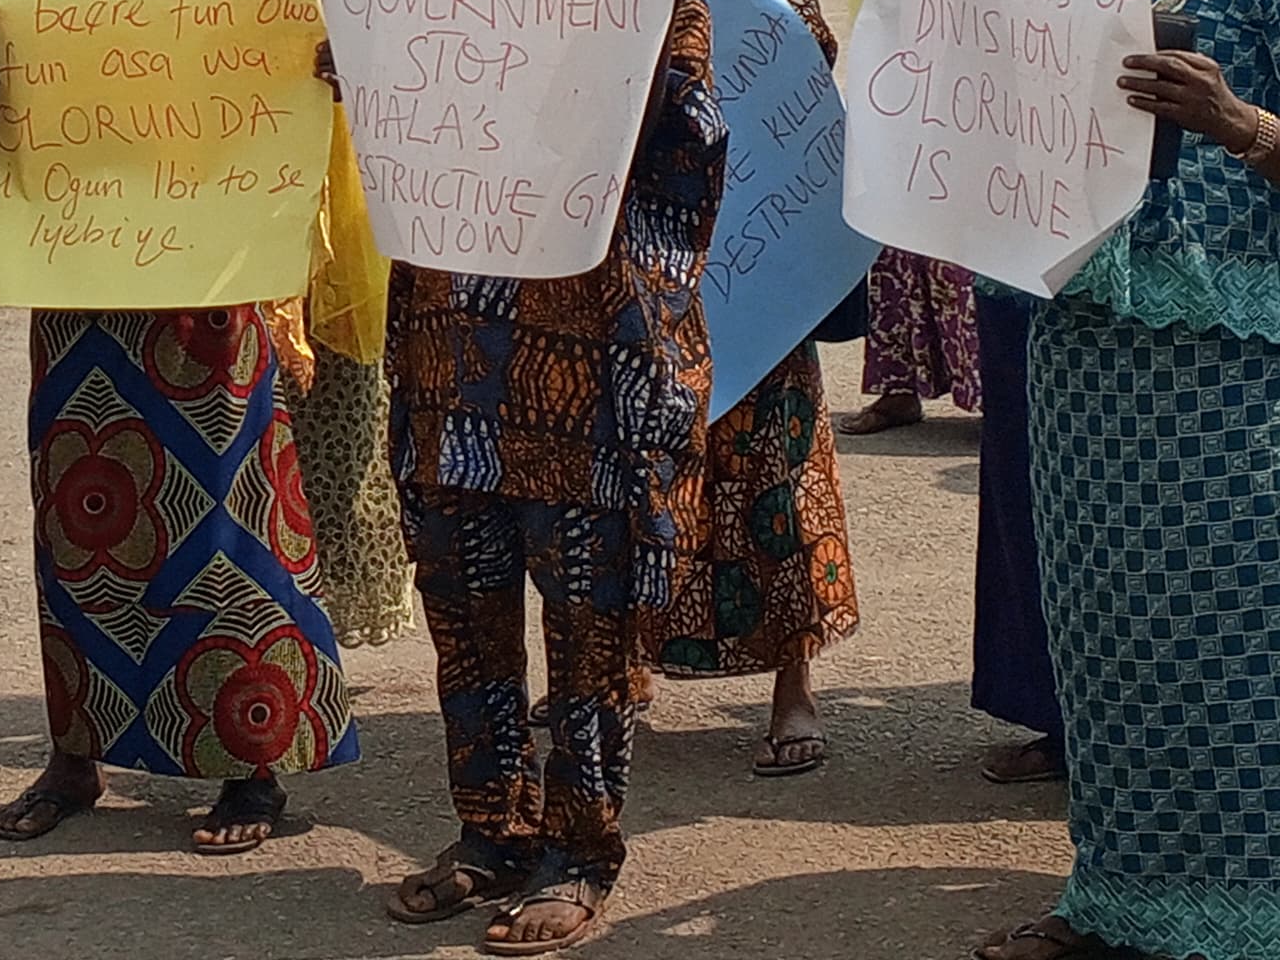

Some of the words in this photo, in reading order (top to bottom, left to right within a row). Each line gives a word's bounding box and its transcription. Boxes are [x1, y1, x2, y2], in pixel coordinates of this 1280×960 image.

[100, 48, 174, 81] asa
[394, 30, 528, 92] STOP
[868, 50, 1125, 170] OLORUNDA
[44, 162, 123, 220] Ogun
[217, 164, 259, 195] to
[907, 143, 951, 201] IS
[987, 165, 1071, 240] ONE
[411, 215, 525, 257] NOW
